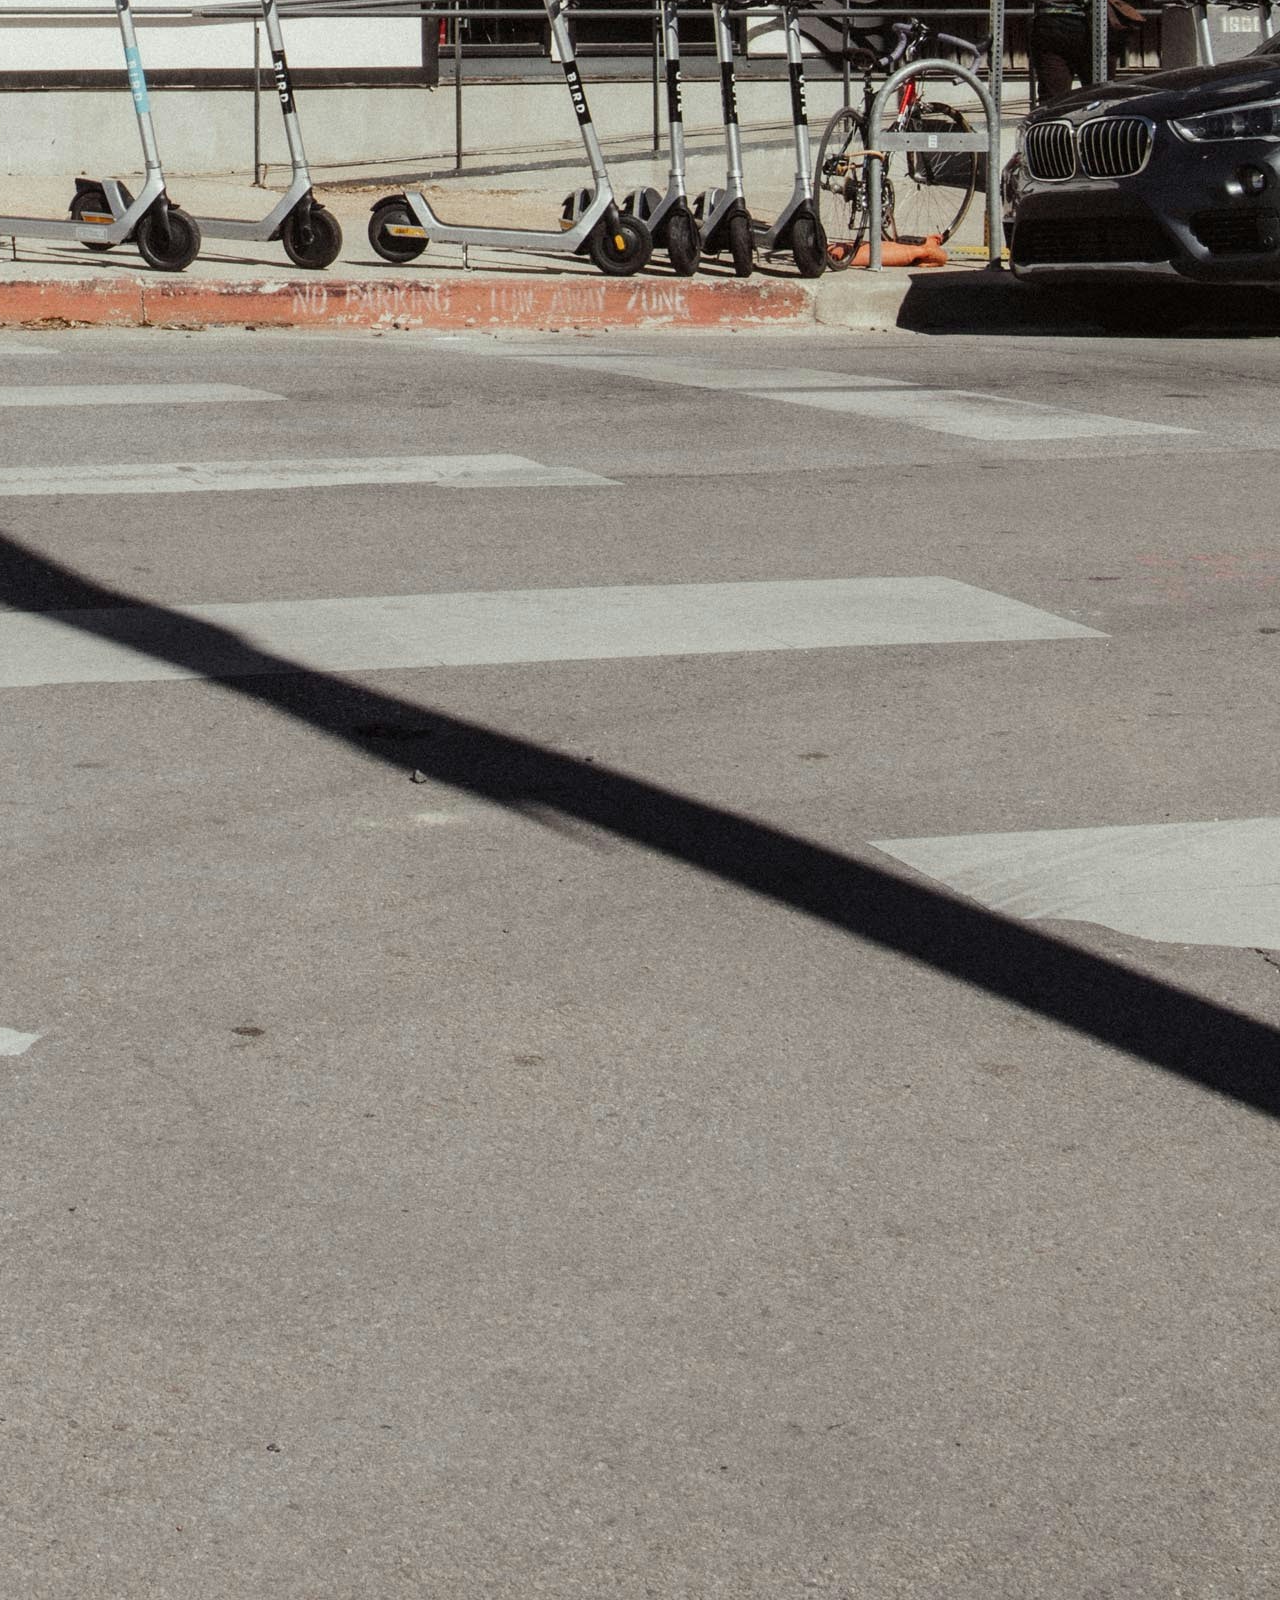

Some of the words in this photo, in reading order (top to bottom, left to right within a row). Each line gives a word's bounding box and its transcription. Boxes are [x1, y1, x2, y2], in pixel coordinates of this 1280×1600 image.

[273, 60, 289, 103] BIRD
[567, 72, 586, 113] BIRD
[293, 286, 328, 315] NO
[346, 285, 451, 312] PARKING
